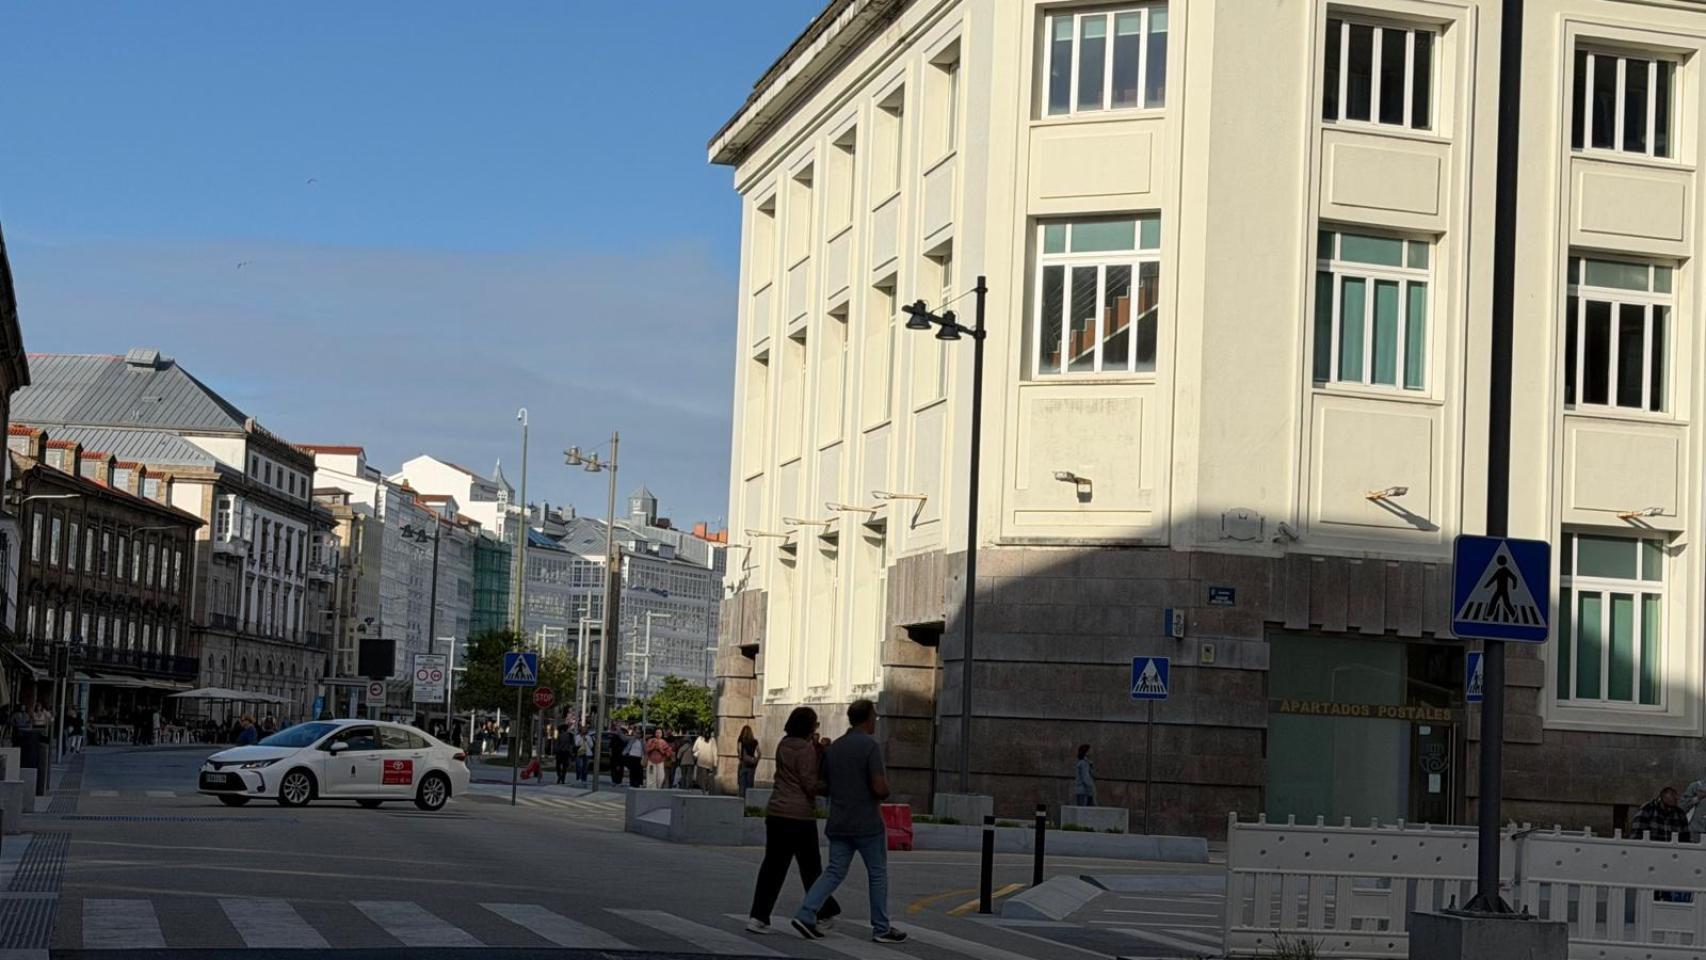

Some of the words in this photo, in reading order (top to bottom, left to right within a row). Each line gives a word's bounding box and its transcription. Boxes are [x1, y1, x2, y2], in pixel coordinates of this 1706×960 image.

[535, 693, 553, 702] STOP
[1280, 699, 1369, 716] APARTADOS
[1377, 705, 1452, 721] POSTALES
